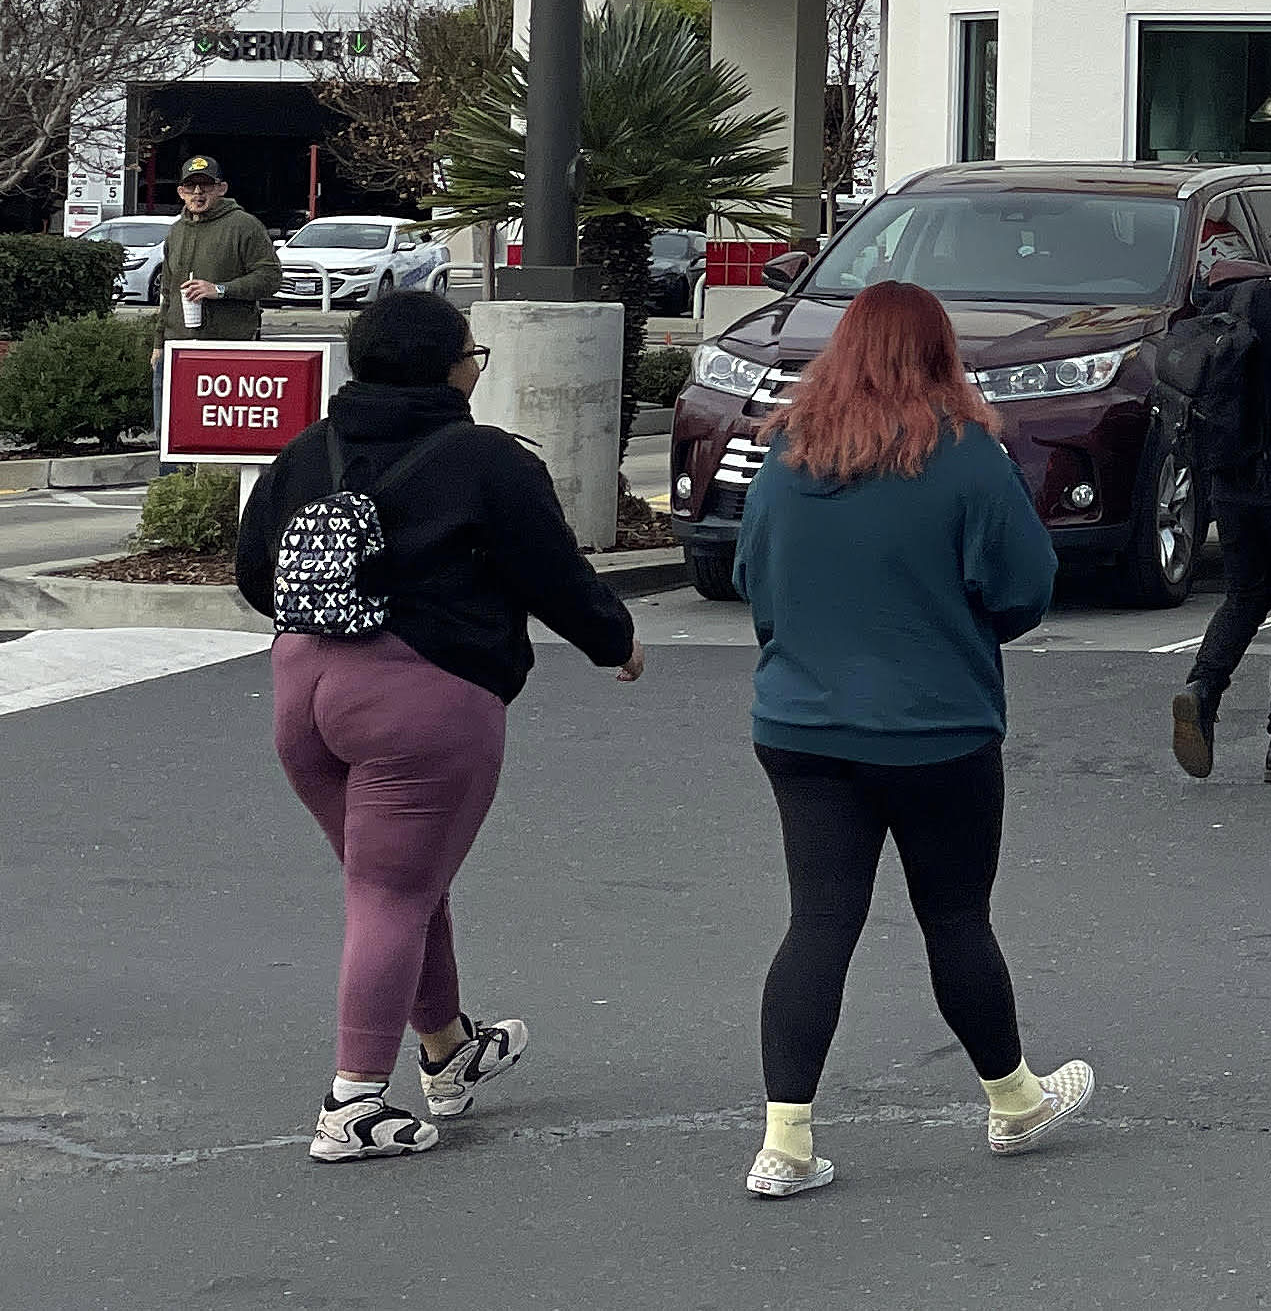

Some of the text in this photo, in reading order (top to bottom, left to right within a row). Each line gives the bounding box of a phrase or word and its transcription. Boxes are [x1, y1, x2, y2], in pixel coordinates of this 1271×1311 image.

[75, 187, 82, 197] 5
[109, 187, 116, 198] 5
[197, 375, 289, 399] DO NOT
[202, 404, 279, 429] ENTER
